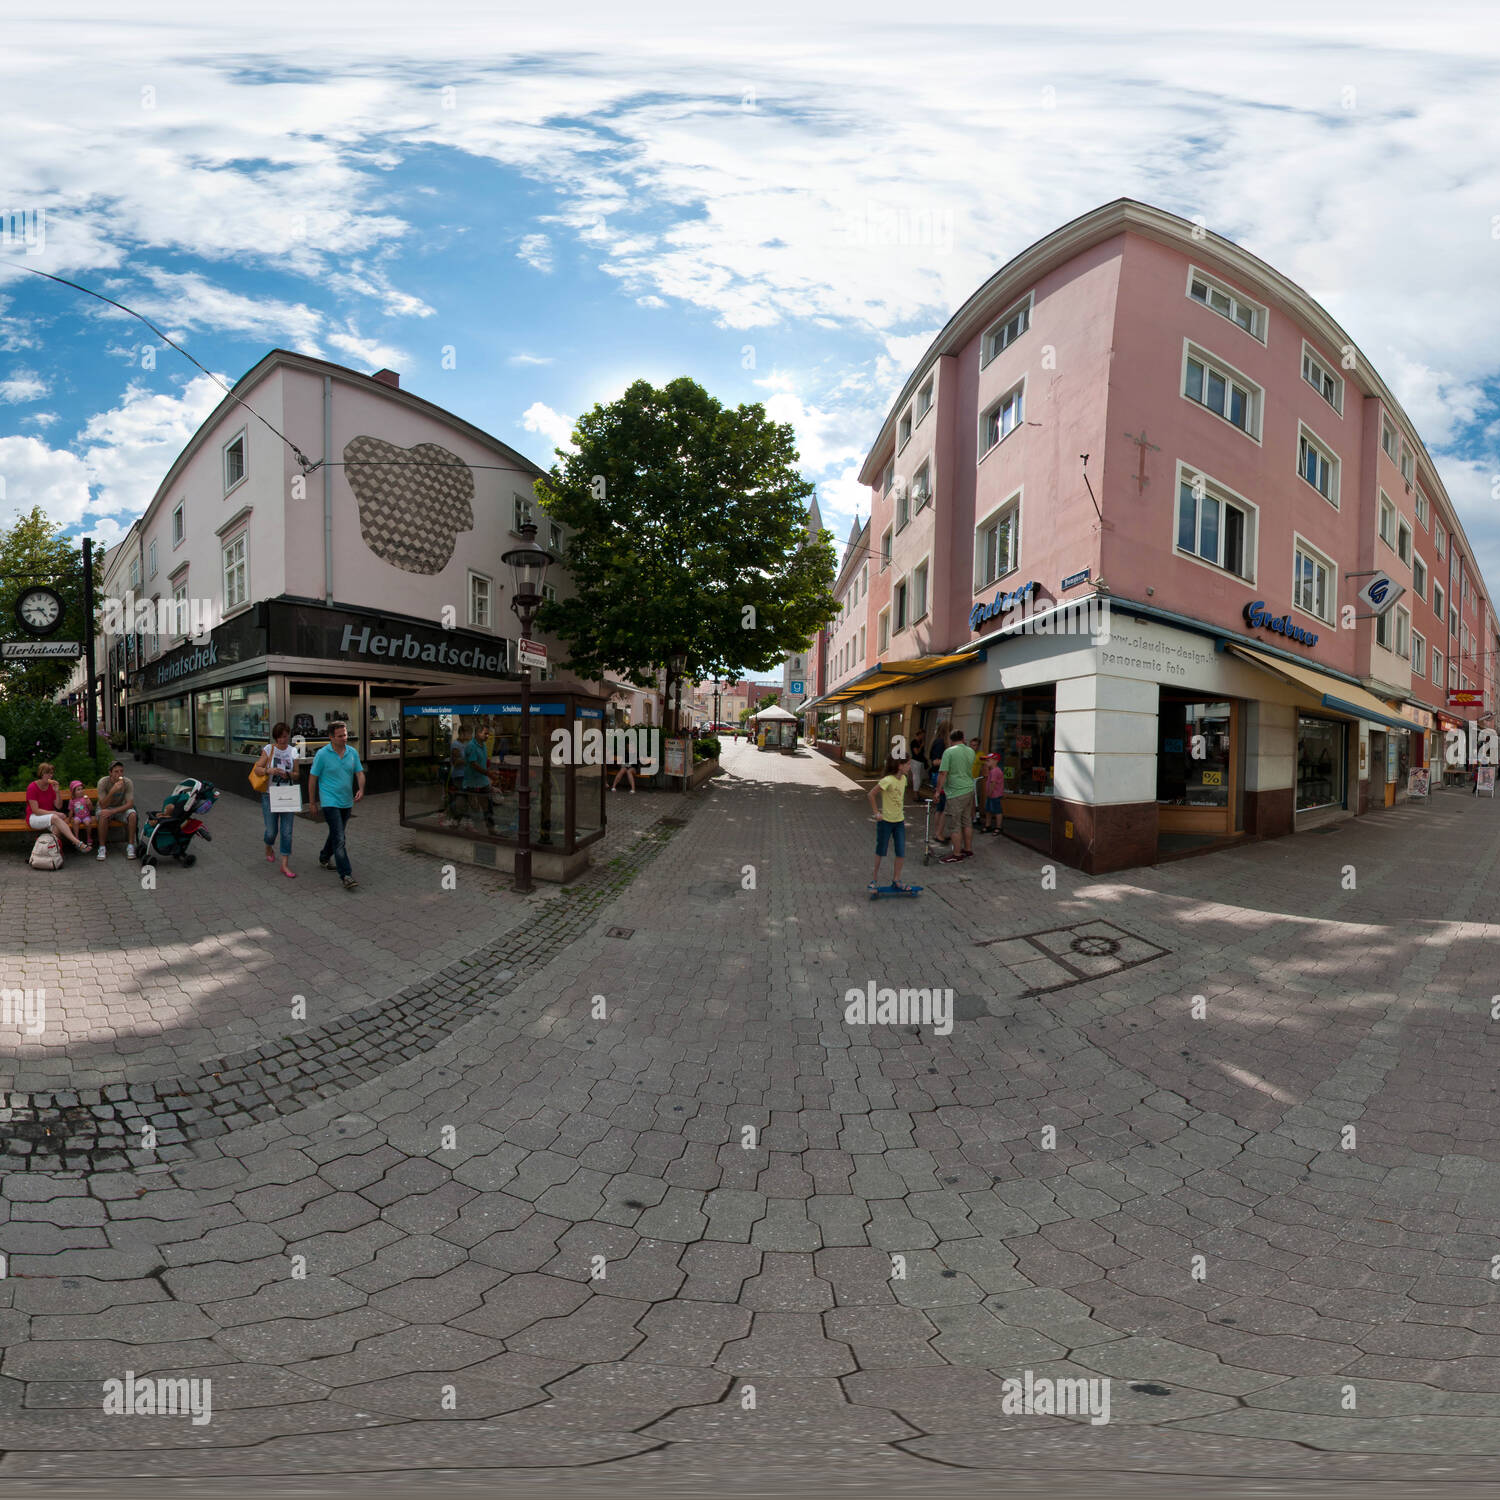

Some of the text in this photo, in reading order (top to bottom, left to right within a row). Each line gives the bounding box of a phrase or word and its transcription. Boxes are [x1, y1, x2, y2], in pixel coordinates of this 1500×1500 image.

[969, 581, 1033, 632] Grabner
[1250, 601, 1319, 647] Grabner
[7, 644, 77, 655] Herbatschek
[340, 624, 508, 673] Herbatschek
[1102, 651, 1185, 676] panoramic foto
